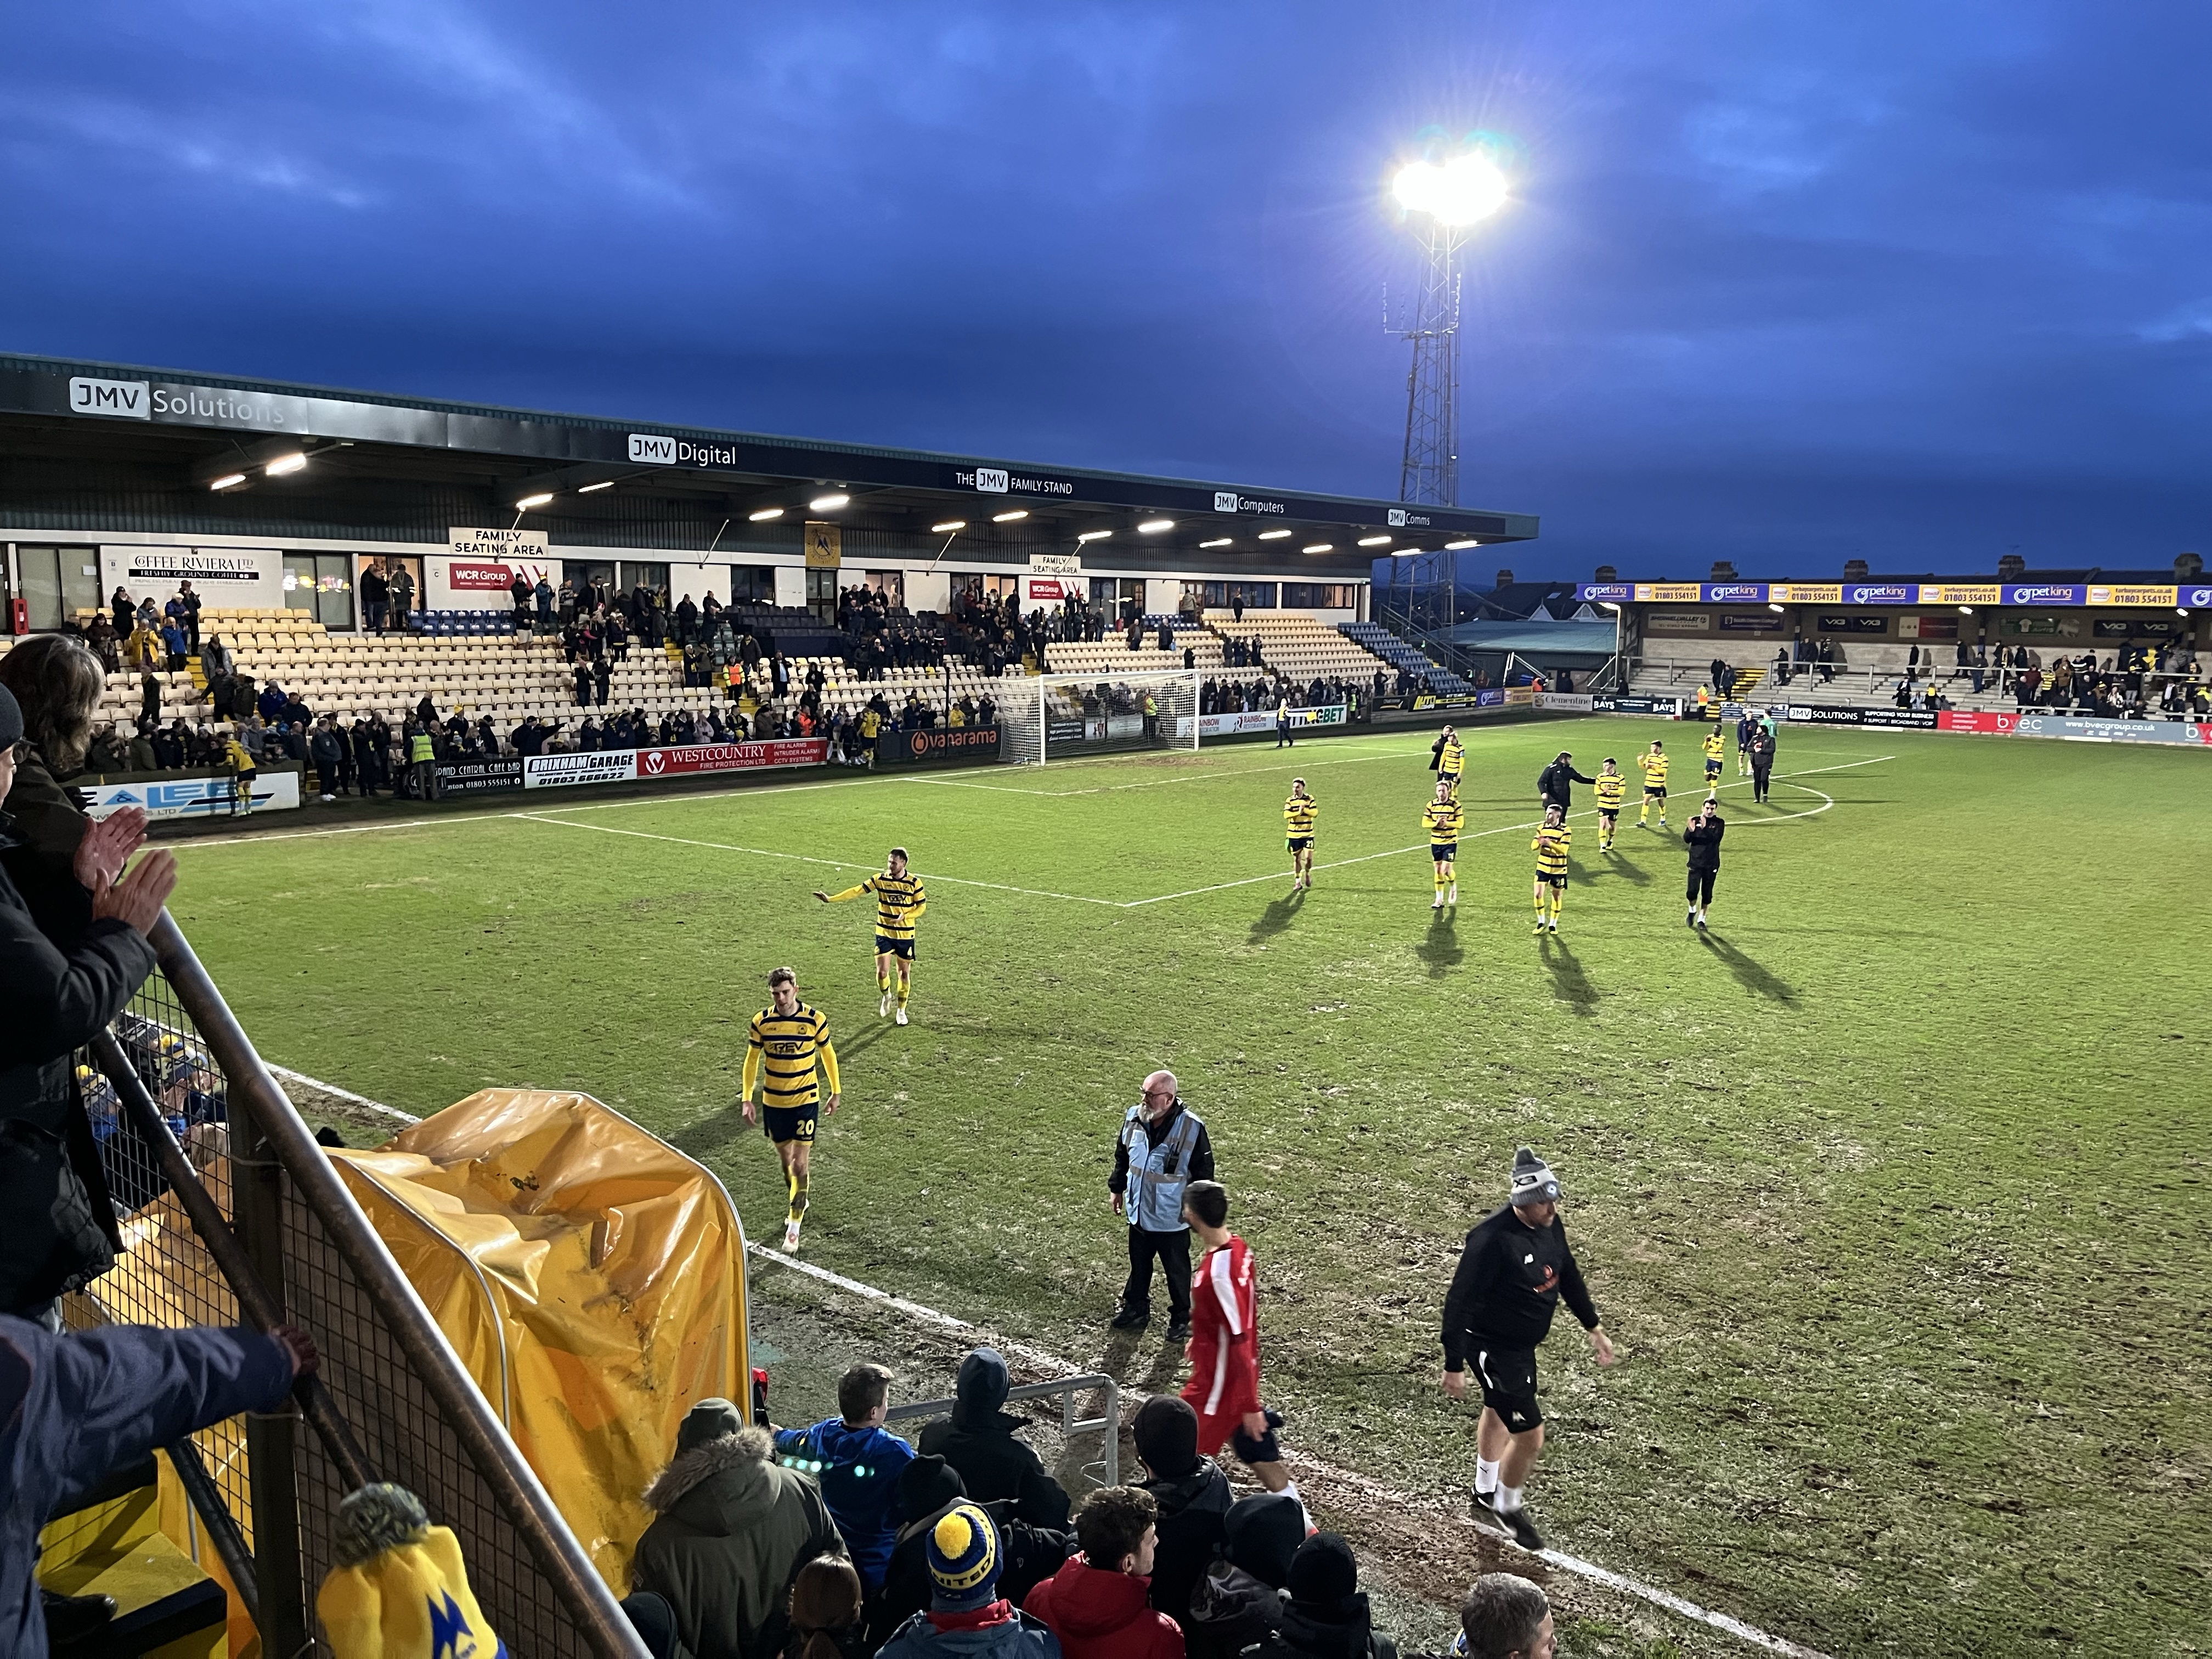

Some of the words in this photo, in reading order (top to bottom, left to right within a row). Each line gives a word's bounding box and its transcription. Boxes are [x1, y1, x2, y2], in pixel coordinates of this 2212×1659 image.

[78, 385, 139, 409] JMV
[153, 390, 284, 424] Solutions
[634, 439, 672, 458] JMV
[679, 442, 735, 466] Digital
[956, 472, 974, 485] THE
[980, 473, 1005, 488] JMV
[1011, 478, 1042, 492] FAMILY
[1044, 481, 1073, 494] STAND
[1217, 496, 1235, 508] JMV
[1238, 497, 1284, 514] Computers
[1390, 512, 1403, 523] JMV
[1406, 513, 1430, 525] Comms
[476, 531, 521, 541] FAMILY
[455, 543, 507, 554] SEATING
[514, 545, 543, 555] AREA
[182, 557, 234, 570] RIVIERA
[1043, 556, 1066, 565] FAMILY
[456, 570, 478, 580] WCR
[480, 571, 507, 582] Group
[1045, 585, 1059, 594] Group
[2142, 595, 2171, 603] 554151
[1545, 696, 1591, 705] Clementine
[1594, 701, 1615, 709] BAYS
[1652, 703, 1675, 713] BAYS
[1813, 710, 1858, 720] SOLUTIONS
[1200, 718, 1220, 726] AINBOW
[2066, 720, 2155, 731] www.bvecgroup.co.uk
[929, 729, 997, 748] vanarama
[672, 746, 766, 763] WESTCOUNTRY
[459, 764, 486, 775] CENTRAL
[488, 763, 505, 772] CAFE
[507, 762, 520, 771] BAR
[531, 756, 588, 772] BRIXHAM
[589, 754, 634, 768] GARAGE
[715, 759, 754, 768] PROTECTION
[488, 778, 510, 787] 555151
[539, 776, 575, 785] 01803
[796, 1119, 814, 1135] 20
[933, 1558, 991, 1586] NITED
